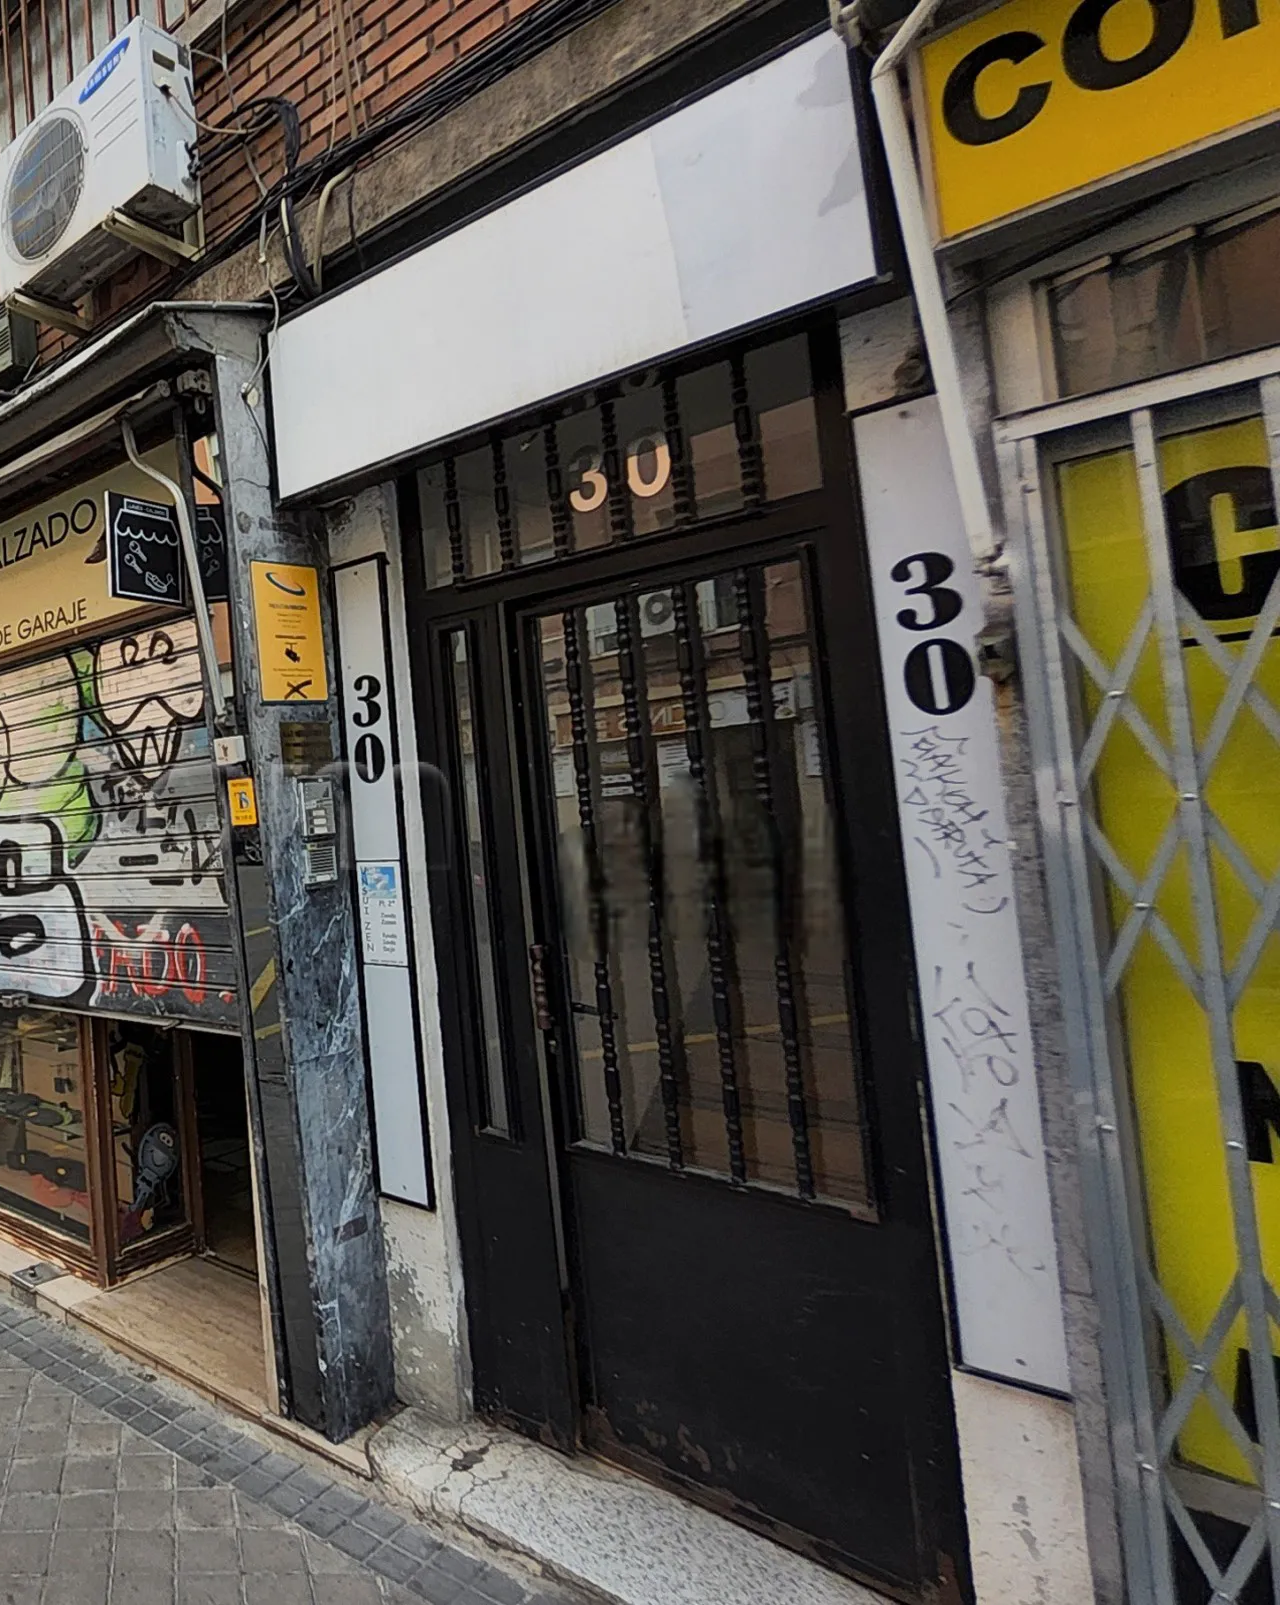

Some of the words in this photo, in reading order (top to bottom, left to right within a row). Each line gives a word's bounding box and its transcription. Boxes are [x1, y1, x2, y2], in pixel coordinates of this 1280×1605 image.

[942, 0, 1261, 146] CO
[569, 428, 671, 512] 30
[17, 598, 87, 640] GARAJE
[890, 551, 975, 716] 30
[353, 675, 386, 784] 30
